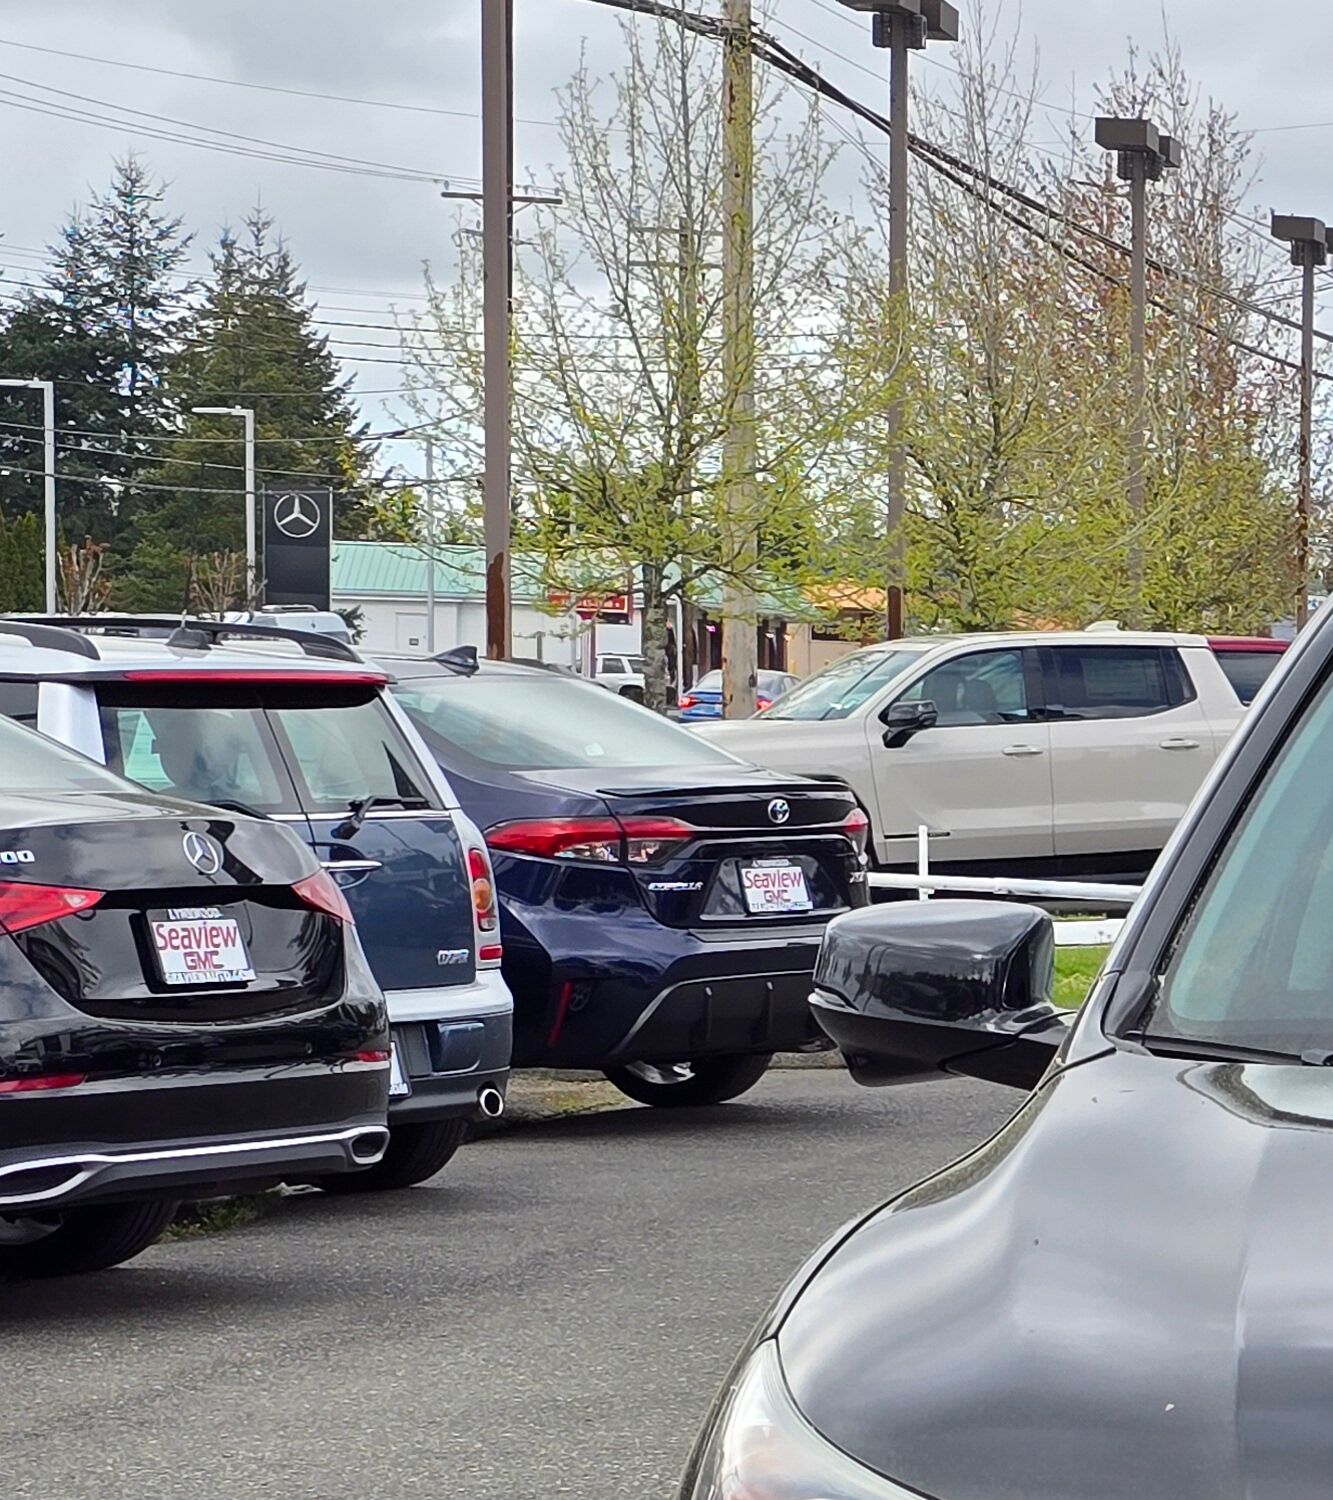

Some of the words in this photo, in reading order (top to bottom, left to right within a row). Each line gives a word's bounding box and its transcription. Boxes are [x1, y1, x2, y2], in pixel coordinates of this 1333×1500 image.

[744, 869, 801, 889] Seaview
[156, 921, 237, 950] Seaview
[183, 950, 224, 971] GMC
